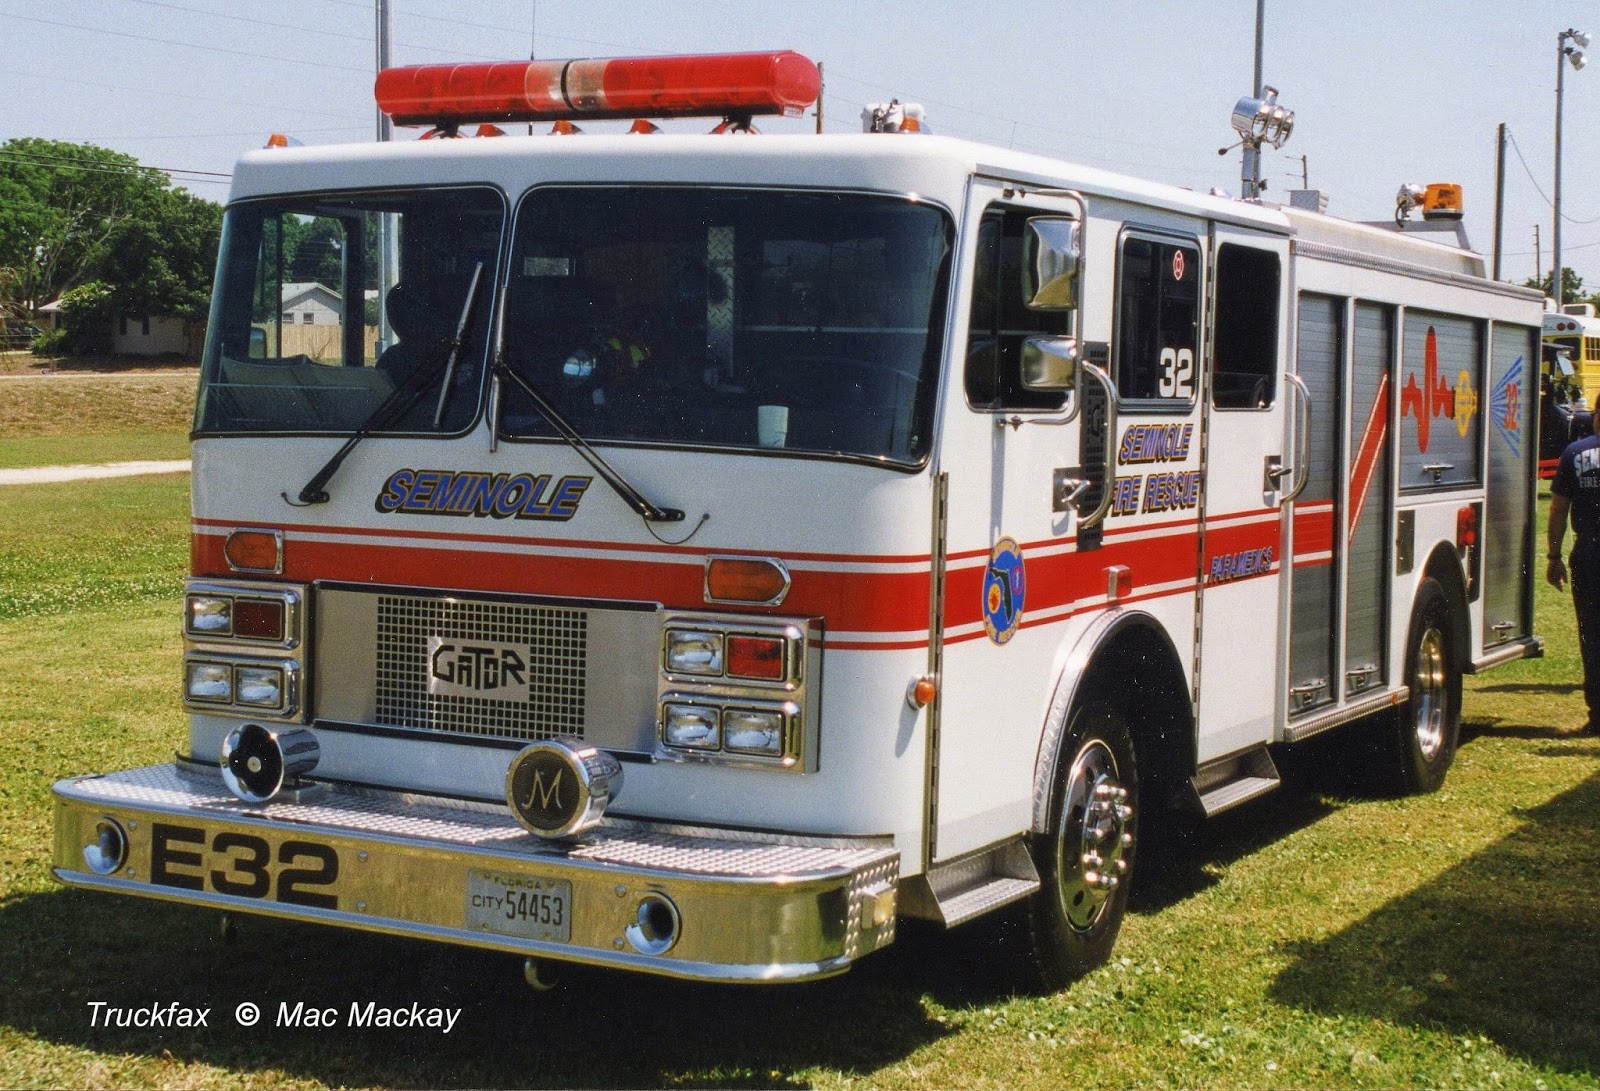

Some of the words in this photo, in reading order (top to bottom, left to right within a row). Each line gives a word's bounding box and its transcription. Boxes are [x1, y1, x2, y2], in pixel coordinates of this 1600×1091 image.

[1159, 347, 1193, 398] 32
[1118, 423, 1194, 466] SEMINOLE
[375, 468, 594, 522] SEMINOLE
[1141, 470, 1201, 515] RESCUE
[1208, 546, 1273, 584] PARAMEDICS
[521, 768, 563, 810] M
[150, 823, 339, 910] E32
[472, 894, 504, 910] CITY
[506, 890, 563, 926] 54453
